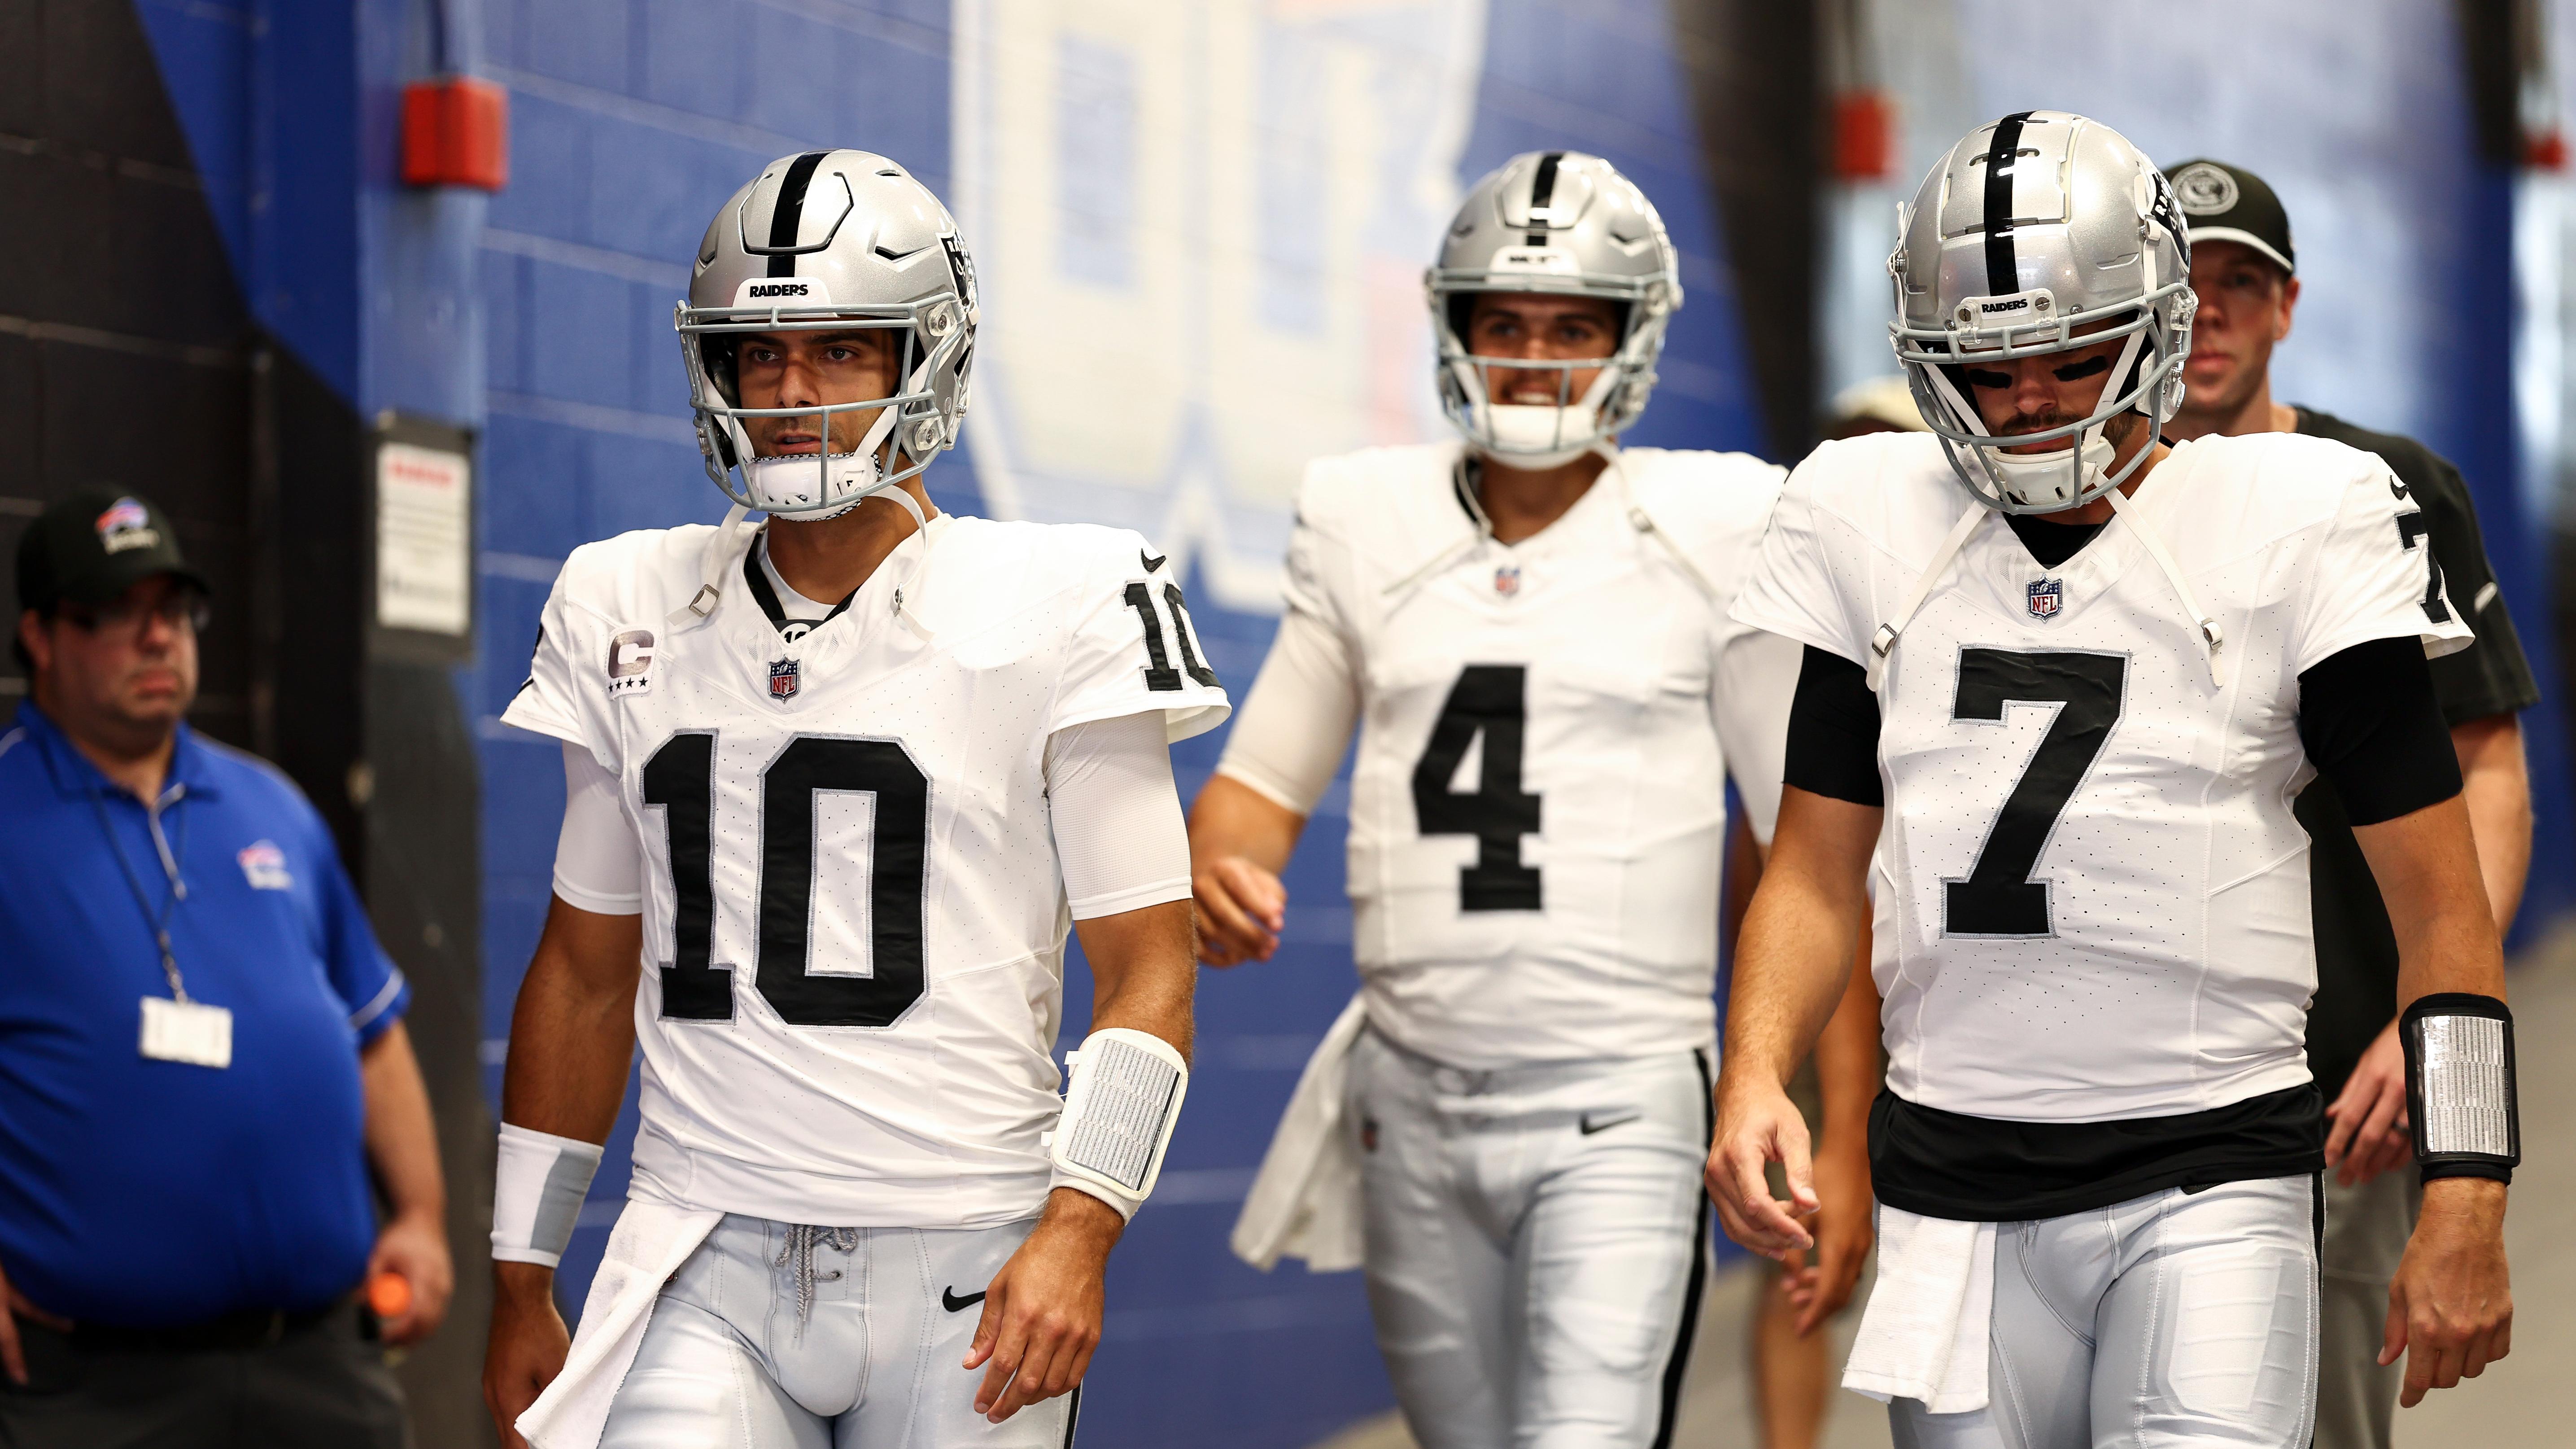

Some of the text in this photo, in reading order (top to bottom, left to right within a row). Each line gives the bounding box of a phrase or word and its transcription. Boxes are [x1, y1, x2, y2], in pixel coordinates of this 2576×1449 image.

[750, 285, 808, 298] RAIDERS
[1982, 299, 2028, 313] RAIDERS
[2032, 596, 2057, 614] NFL
[608, 630, 654, 679] C
[772, 676, 795, 694] NFL
[1412, 665, 1543, 911] 4
[1940, 643, 2133, 939] 7
[640, 728, 933, 1031] 10
